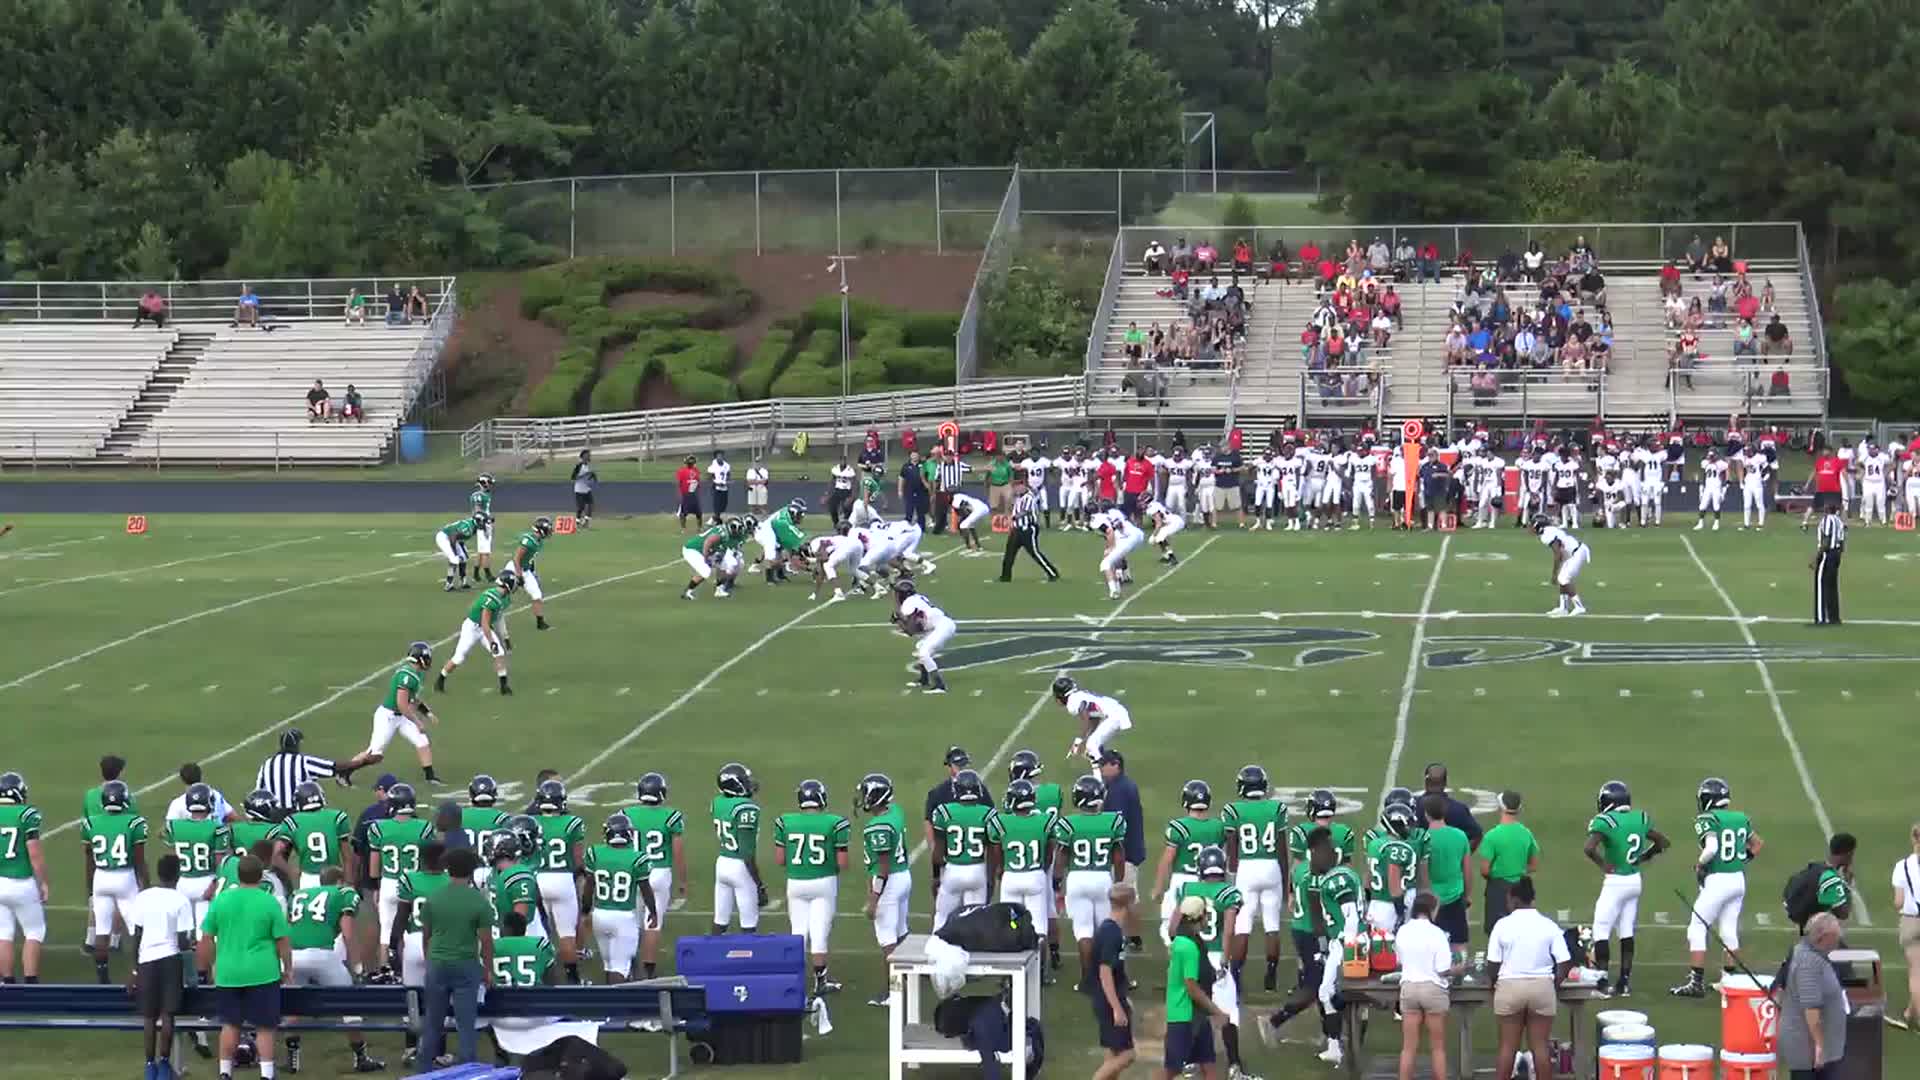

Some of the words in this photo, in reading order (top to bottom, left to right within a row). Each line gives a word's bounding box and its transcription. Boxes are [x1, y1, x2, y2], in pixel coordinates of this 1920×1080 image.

[128, 516, 144, 530] 20
[556, 517, 573, 531] 30
[993, 515, 1009, 529] 40
[1897, 514, 1913, 528] 40
[93, 834, 128, 866] 24
[307, 832, 327, 862] 9
[788, 833, 826, 865] 75
[947, 825, 984, 857] 35
[1073, 838, 1111, 867] 95
[1239, 822, 1276, 854] 84
[1626, 833, 1641, 864] 2
[1720, 828, 1747, 861] 83
[175, 843, 209, 871] 58
[382, 845, 419, 872] 33
[1007, 839, 1041, 869] 31
[594, 869, 631, 902] 68
[290, 891, 328, 922] 64
[493, 955, 537, 987] 55
